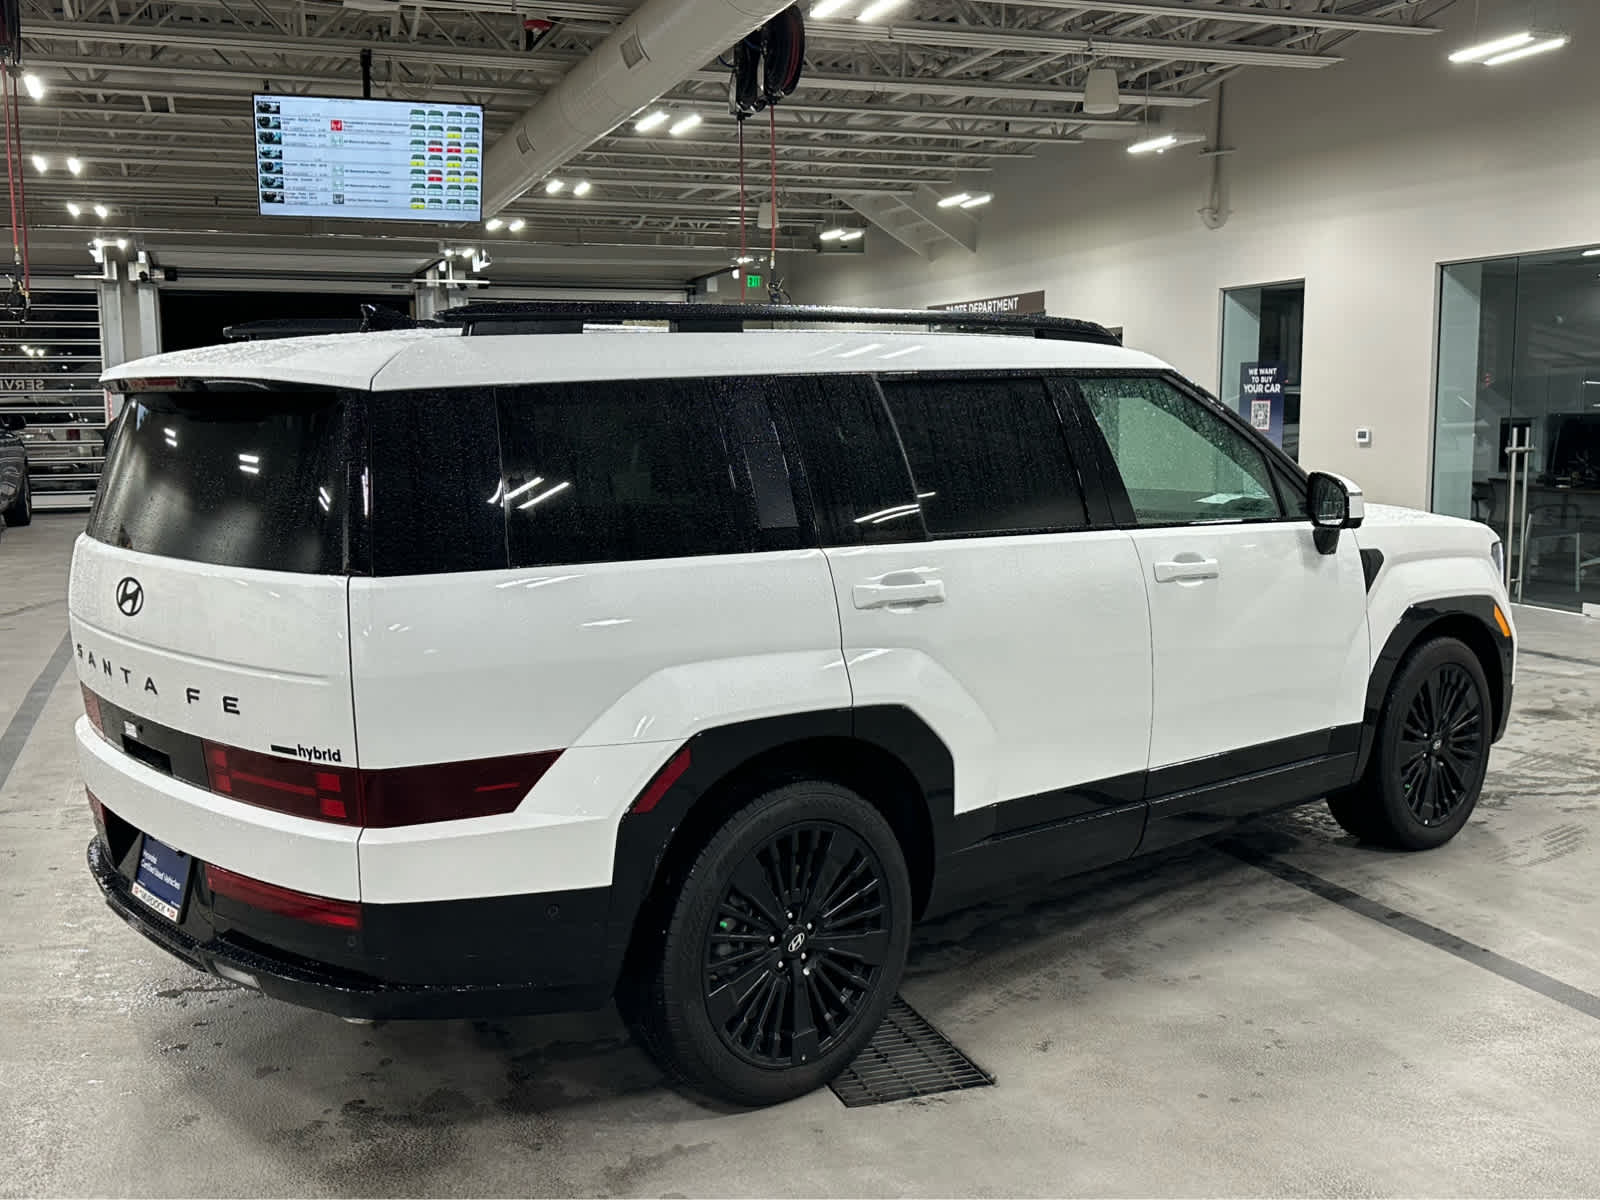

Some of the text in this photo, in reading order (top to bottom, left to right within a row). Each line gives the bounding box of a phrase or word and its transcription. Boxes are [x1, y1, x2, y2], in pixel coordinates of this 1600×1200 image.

[969, 297, 1019, 313] DEPARTMENT
[1259, 367, 1277, 375] WANT
[1243, 384, 1281, 393] YOUR CAR
[77, 643, 240, 715] SANTA FE
[297, 744, 341, 762] hybrid
